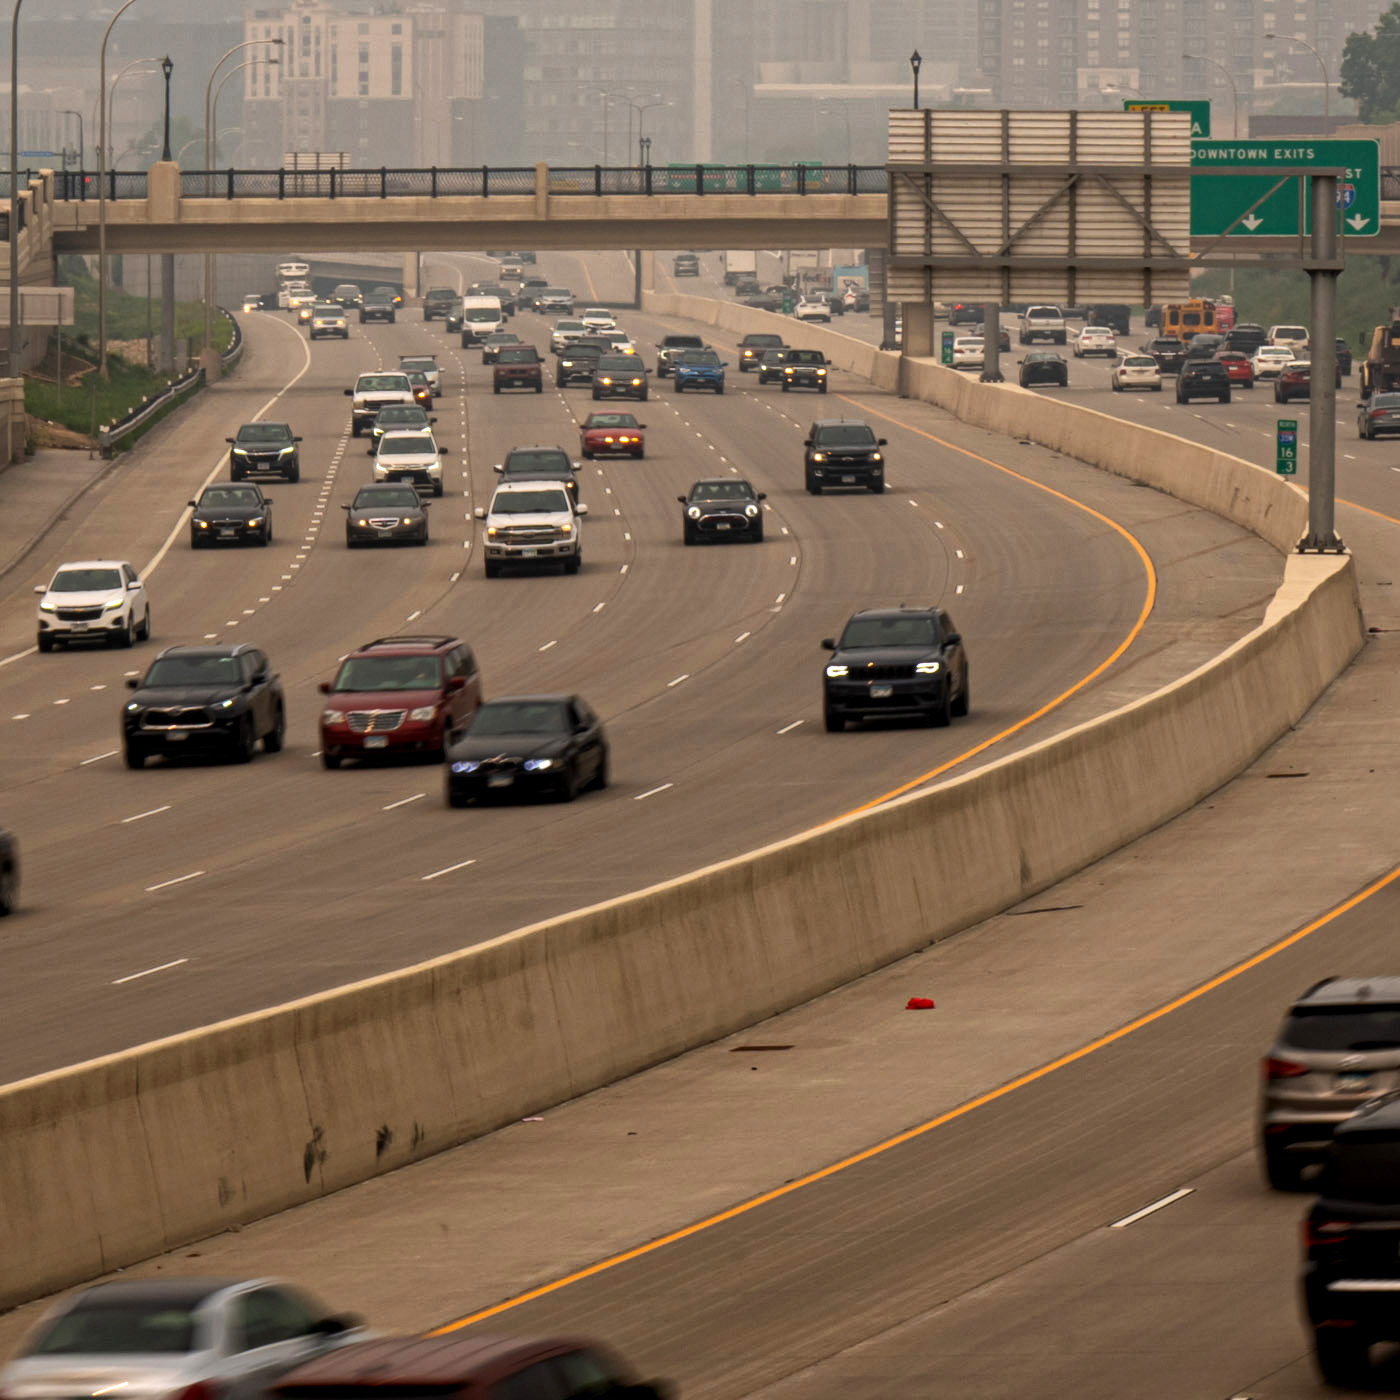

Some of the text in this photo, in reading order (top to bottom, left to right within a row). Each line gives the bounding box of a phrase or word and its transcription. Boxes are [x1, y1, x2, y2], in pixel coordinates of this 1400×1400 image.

[1190, 148, 1315, 160] DOWNTOWN EXITS
[1281, 447, 1293, 458] 16
